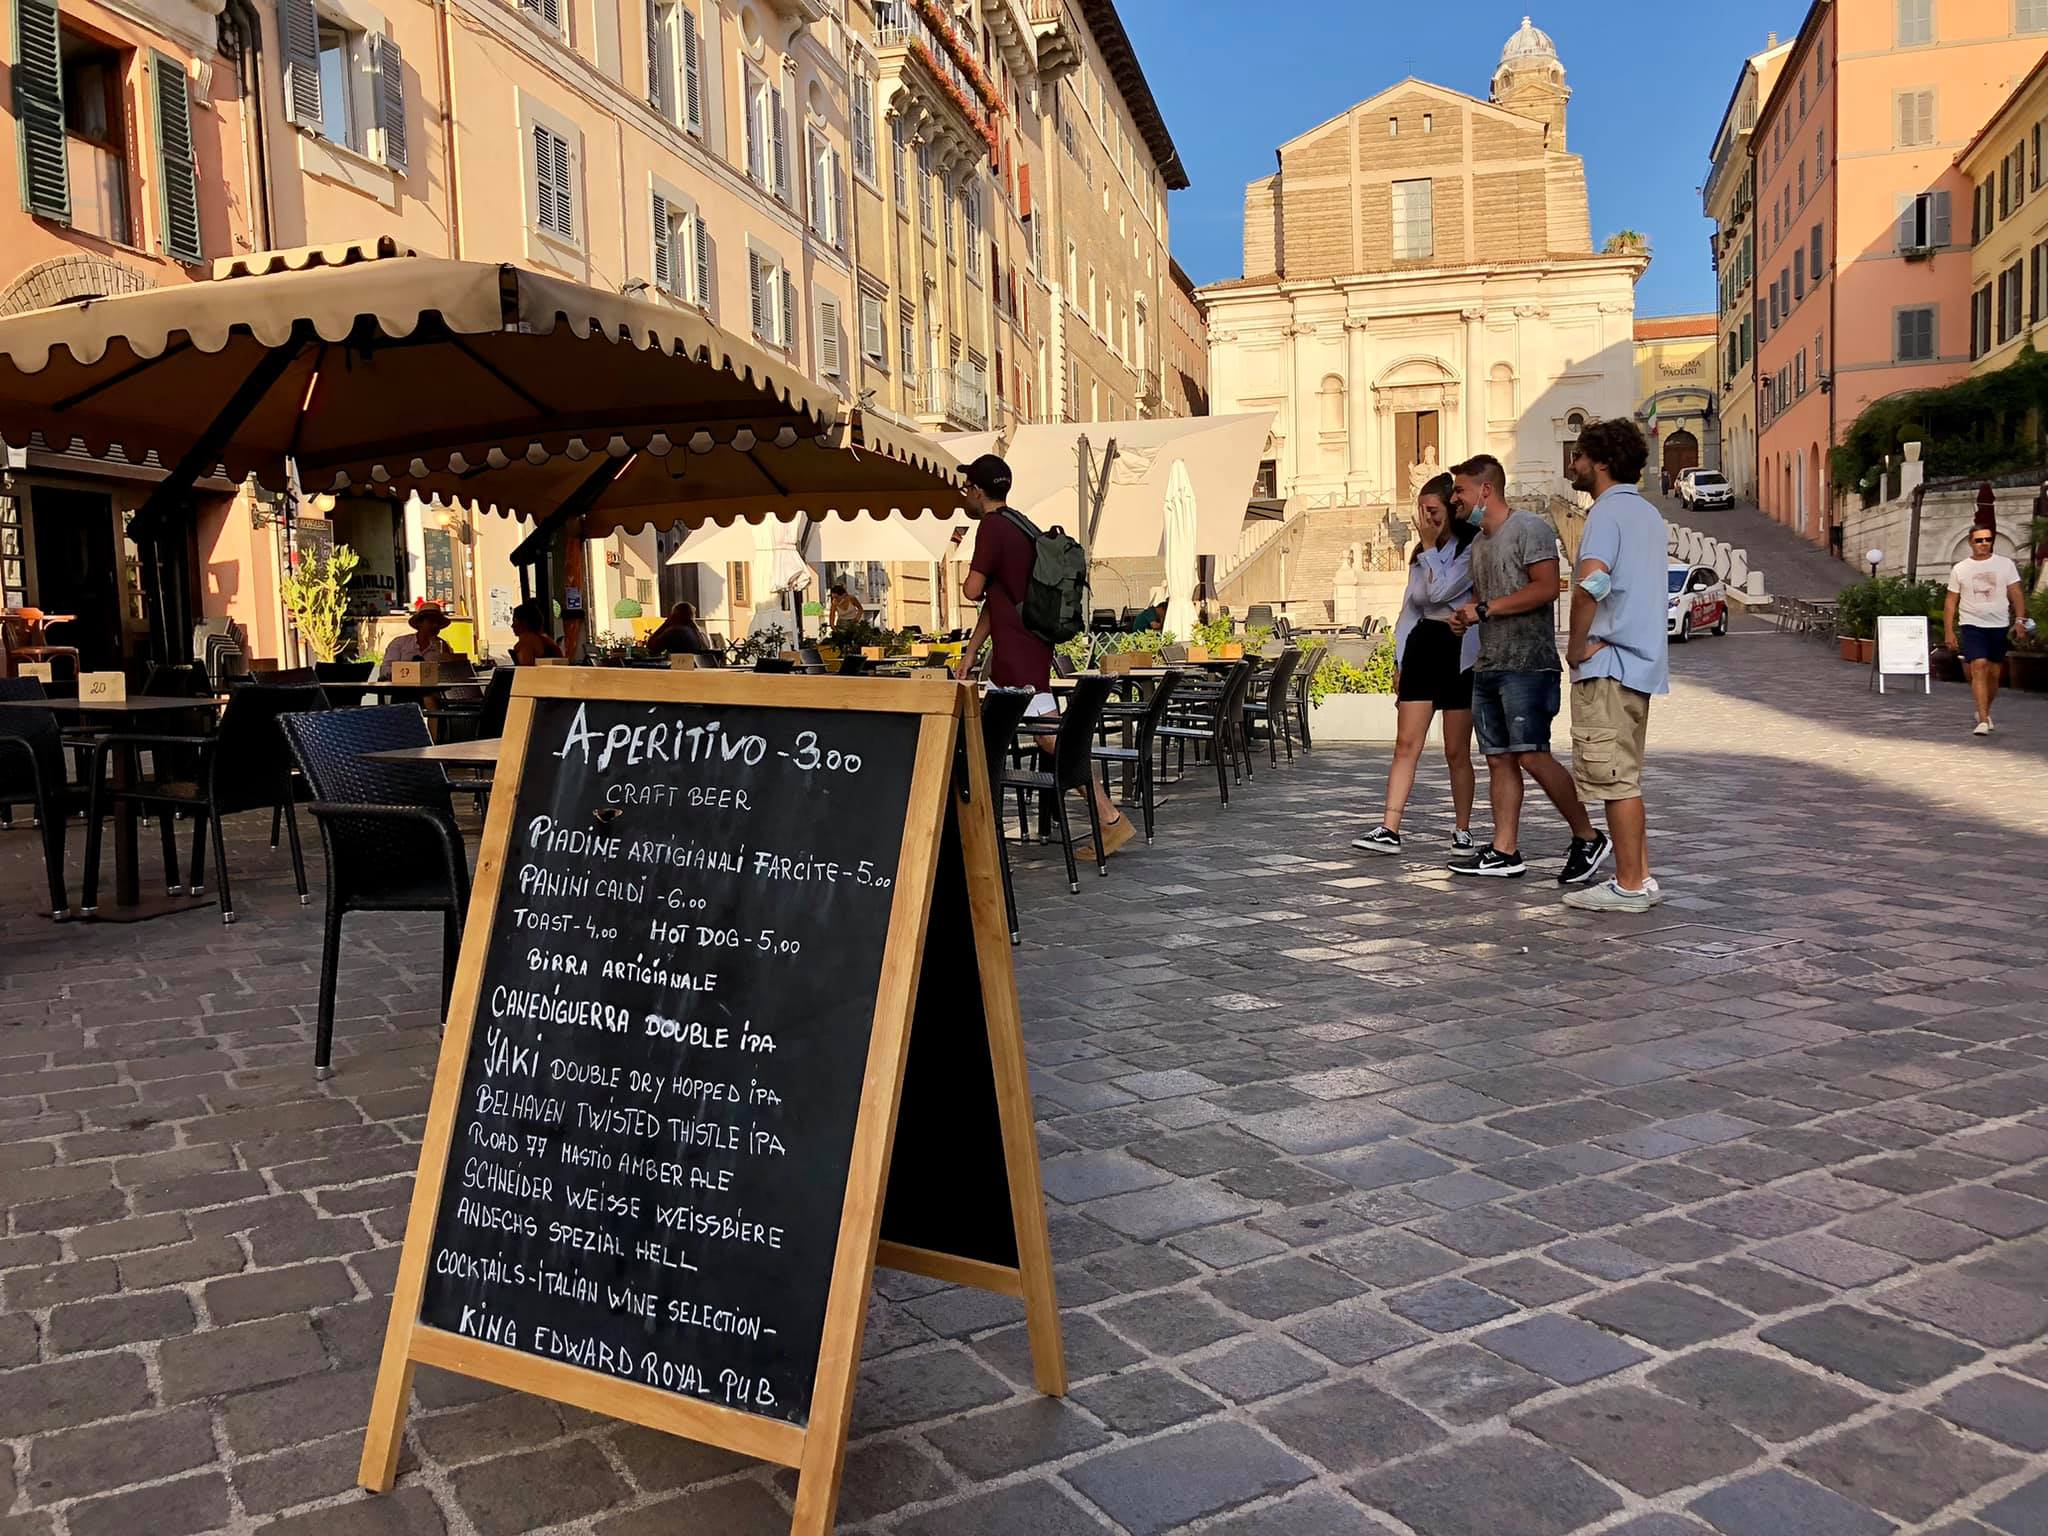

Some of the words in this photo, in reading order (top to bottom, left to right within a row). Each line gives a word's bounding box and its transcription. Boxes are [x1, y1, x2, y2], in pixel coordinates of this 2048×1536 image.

[1663, 367, 1697, 377] PAOLINI
[90, 681, 107, 695] 20
[606, 783, 679, 806] CRAFT
[688, 786, 751, 811] BEER
[529, 815, 622, 859] PIADINE
[628, 834, 745, 873] ARTIGIANALI
[519, 864, 590, 897] PANINI
[595, 875, 648, 904] CALDI
[650, 919, 690, 944] HOT
[527, 948, 588, 976] BIRRA
[602, 953, 718, 991] ARTIGIANALE
[491, 984, 630, 1034] CANEDIGUERRA
[645, 1014, 729, 1049] DOUBLE
[740, 1020, 777, 1053] IPA
[484, 1025, 543, 1078] YAKI
[550, 1058, 622, 1088] DOUBLE
[629, 1070, 666, 1104] DRY
[672, 1076, 741, 1102] HOPPED
[749, 1078, 782, 1106] IPA
[476, 1083, 566, 1124] BELHAVEN
[577, 1096, 661, 1138] TWISTED
[667, 1115, 740, 1150] THISTLE
[749, 1120, 786, 1156] IPA
[468, 1121, 519, 1153] ROAD
[526, 1134, 548, 1158] 77
[618, 1152, 683, 1187] AMBER
[690, 1167, 735, 1191] ALE
[462, 1157, 553, 1202] SCHNEIDER
[566, 1180, 641, 1219] WEISSE
[656, 1203, 784, 1249] WEISSBIERE
[457, 1197, 538, 1237] ANDECHS
[549, 1221, 625, 1257] SPEZIAL
[635, 1240, 698, 1272] HELL
[607, 1280, 659, 1317] WINE
[459, 1301, 517, 1347] KING
[534, 1326, 633, 1375] EDWARD
[641, 1351, 711, 1394] ROYAL
